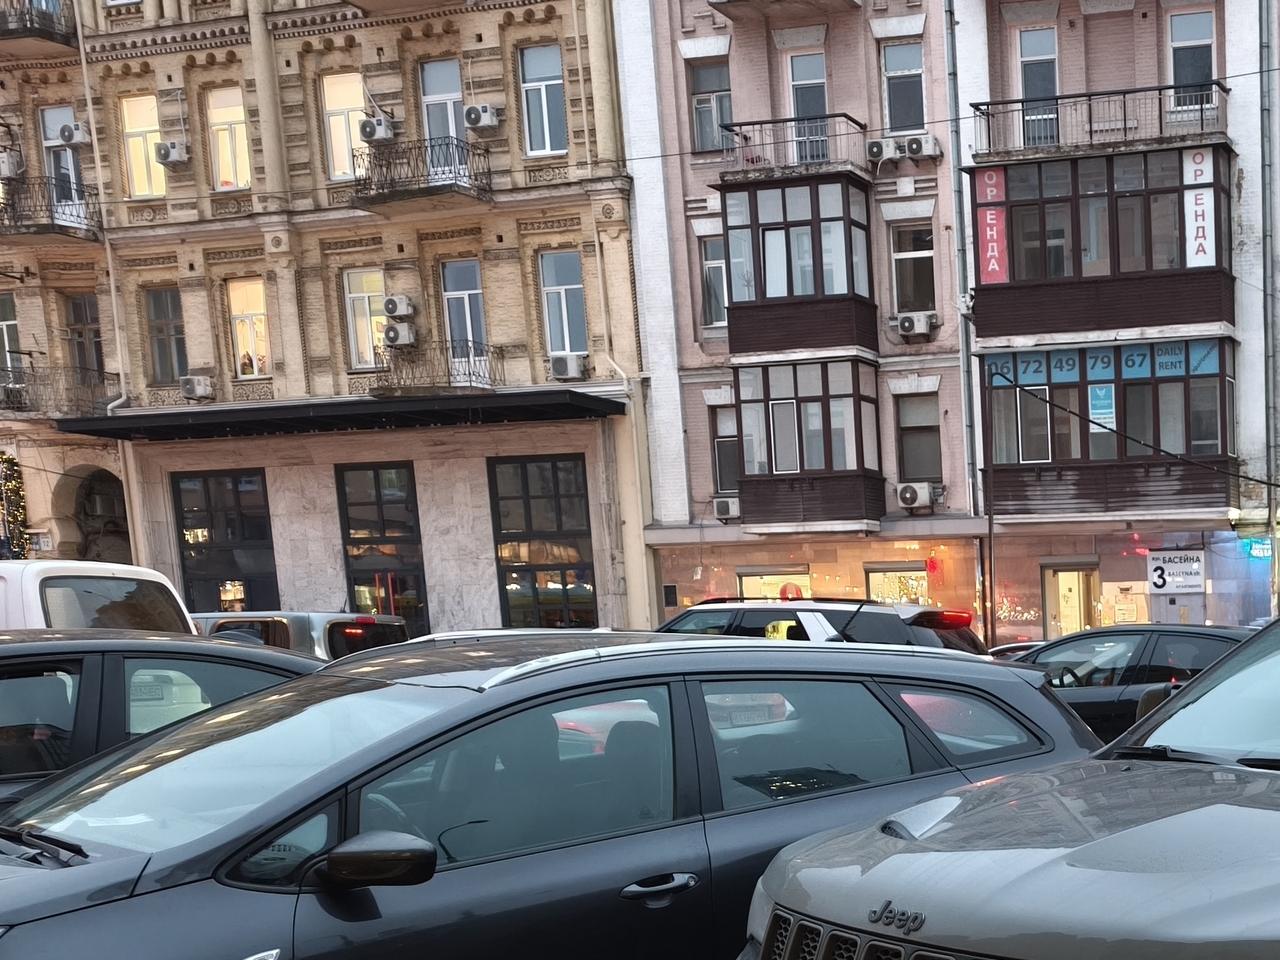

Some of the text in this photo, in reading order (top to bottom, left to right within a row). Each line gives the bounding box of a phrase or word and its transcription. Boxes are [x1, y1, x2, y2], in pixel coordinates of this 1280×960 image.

[1192, 152, 1207, 255] ОРЕНДА
[984, 171, 1000, 271] ОРЕНДА
[1157, 346, 1183, 357] DAILY
[1020, 359, 1043, 374] 72
[1053, 357, 1077, 373] 49
[1088, 355, 1112, 370] 79
[1124, 353, 1147, 369] 67
[1158, 360, 1183, 371] RENT
[1162, 554, 1201, 564] БАСЕЙНА
[1153, 566, 1167, 589] 3
[868, 900, 926, 935] Jeep
